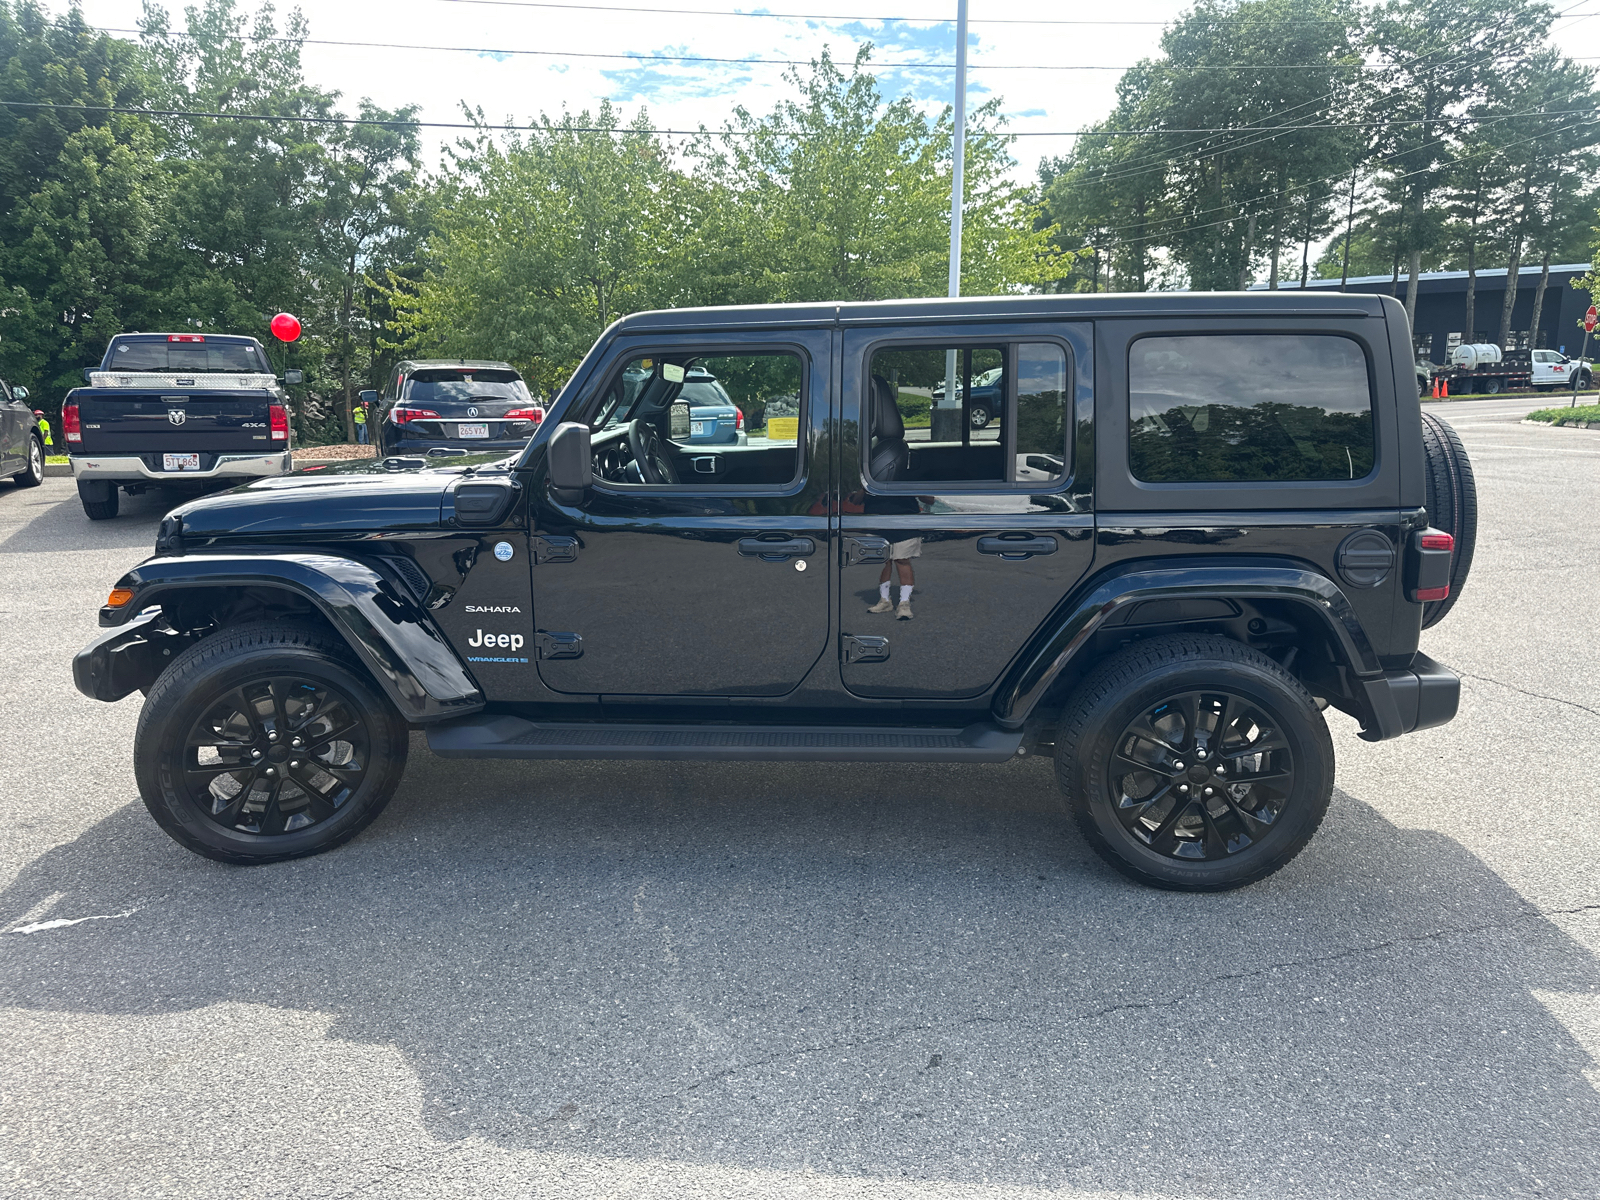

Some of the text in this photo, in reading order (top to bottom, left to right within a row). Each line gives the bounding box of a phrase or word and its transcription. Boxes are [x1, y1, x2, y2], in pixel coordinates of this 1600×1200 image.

[460, 427, 487, 435] 265 VX7
[182, 458, 198, 466] 865
[465, 605, 521, 613] SAHARA
[468, 629, 524, 652] Jeep
